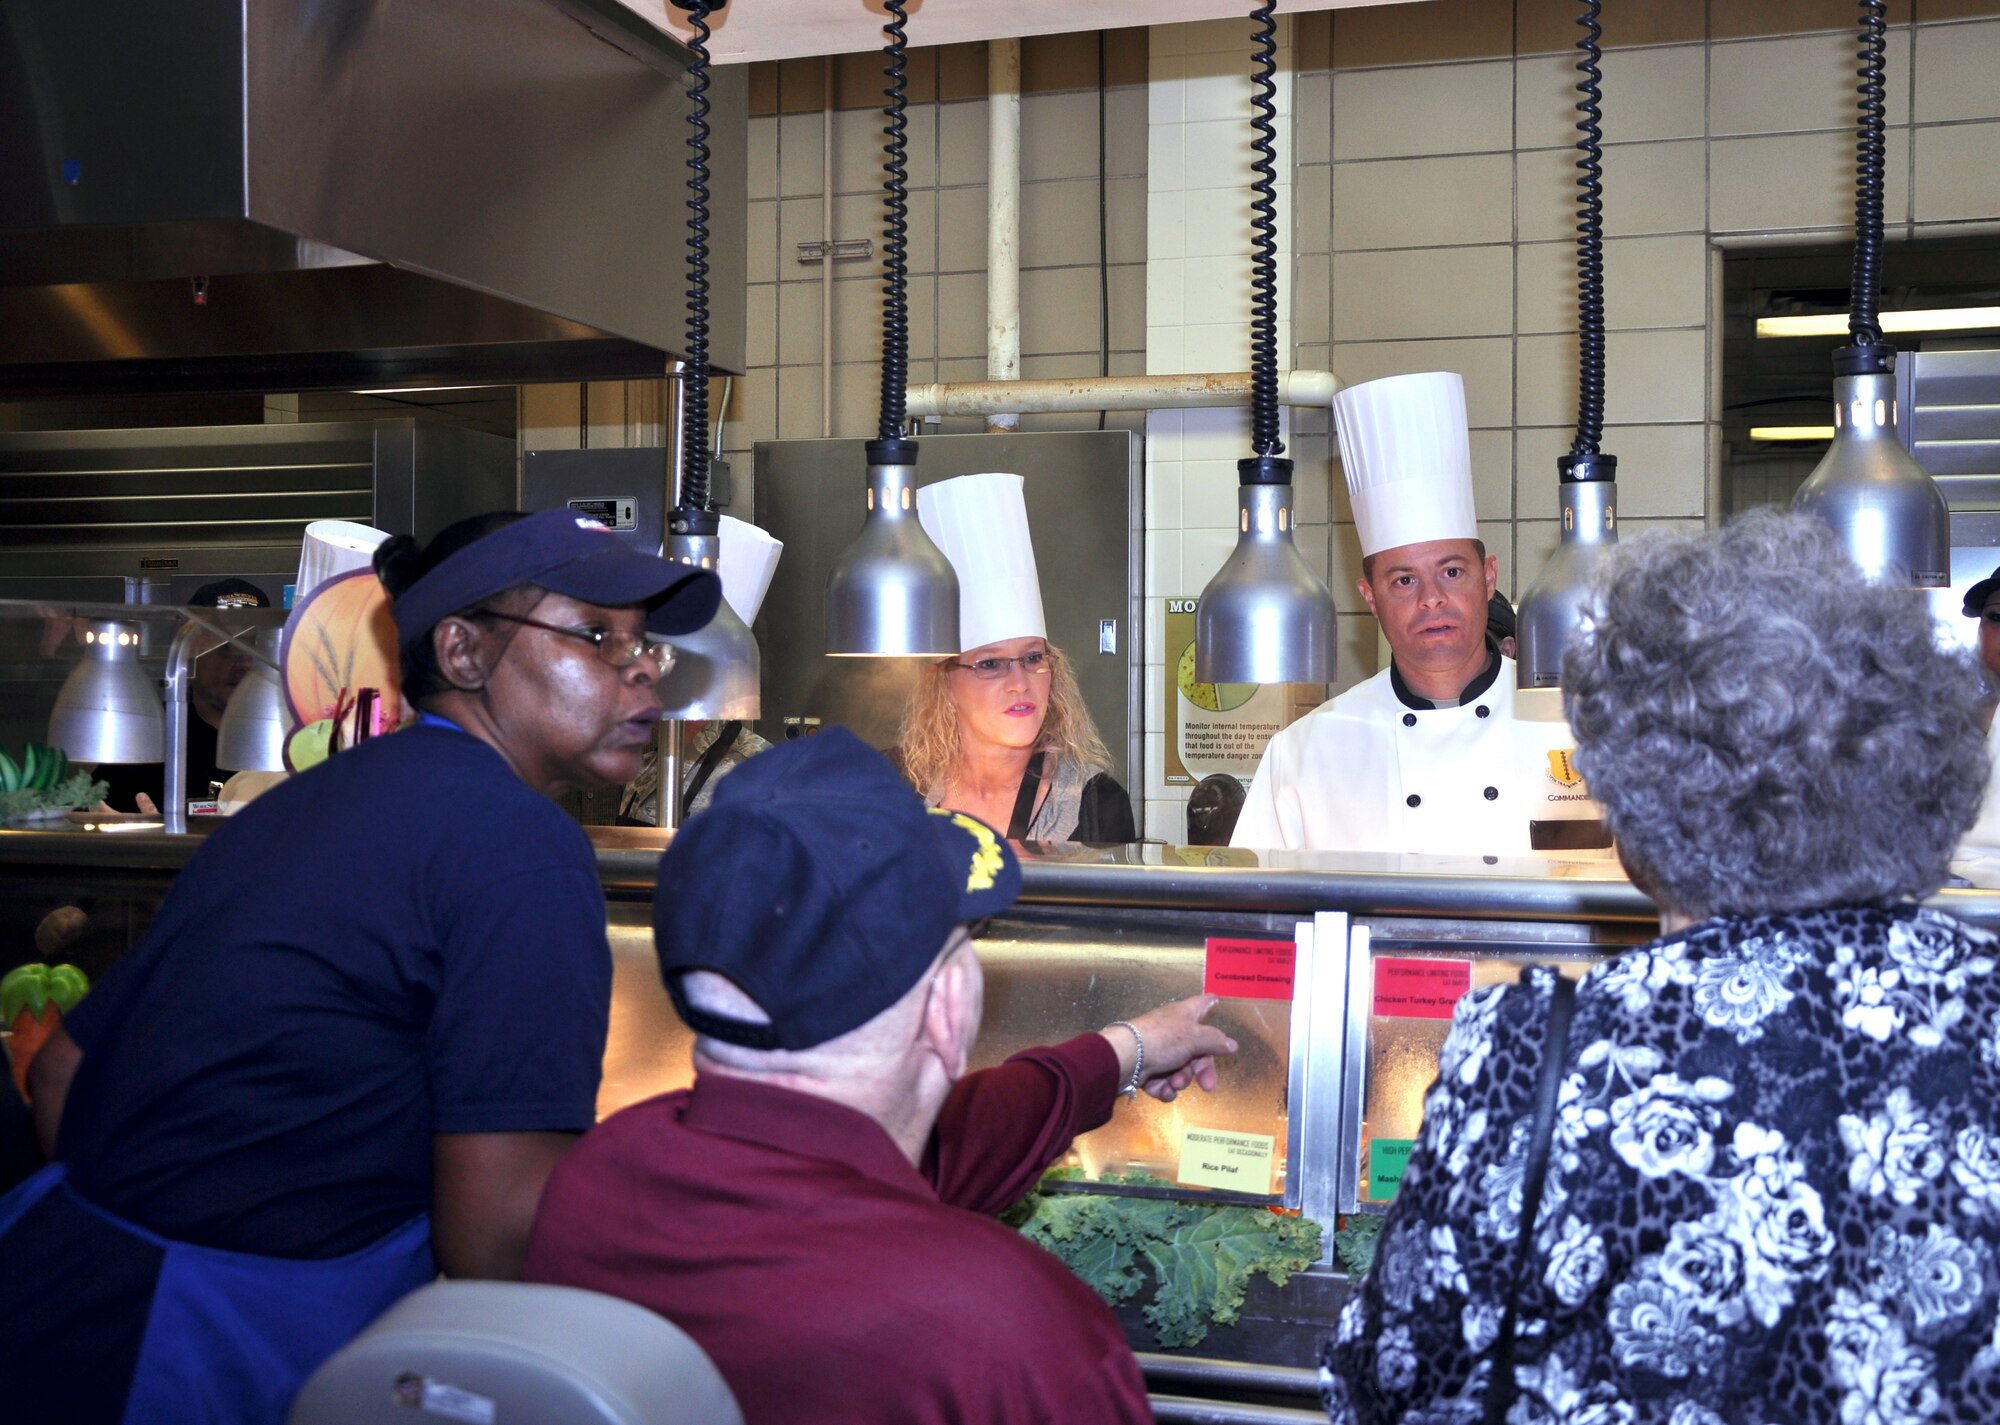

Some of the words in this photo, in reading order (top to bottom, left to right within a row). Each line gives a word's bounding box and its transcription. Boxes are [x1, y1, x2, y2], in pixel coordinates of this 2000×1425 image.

[1169, 600, 1198, 613] MO
[1185, 722, 1211, 730] Monitor
[1212, 722, 1238, 730] internal
[1239, 722, 1280, 731] temperature
[1185, 732, 1220, 741] throughout
[1221, 732, 1233, 740] the
[1234, 732, 1246, 741] day
[1248, 732, 1255, 740] to
[1185, 742, 1198, 750] that
[1199, 742, 1214, 750] food
[1215, 742, 1222, 750] is
[1223, 742, 1235, 750] out
[1236, 742, 1243, 750] of
[1244, 742, 1255, 750] the
[1185, 752, 1225, 760] temperature
[1226, 752, 1250, 761] danger
[1387, 968, 1425, 976] PERFORMANCE
[1215, 972, 1255, 981] Cornbread
[1257, 974, 1291, 984] Dressing
[1374, 995, 1407, 1003] Chicken
[1409, 996, 1436, 1006] Turkey
[1438, 997, 1457, 1005] Grav
[1187, 1133, 1213, 1143] MODERATE
[1213, 1136, 1250, 1147] PERFORMANCE
[1250, 1140, 1269, 1150] FOODS
[1382, 1146, 1397, 1155] HIGH
[1202, 1162, 1219, 1171] Rice
[1221, 1164, 1239, 1173] Pilaf
